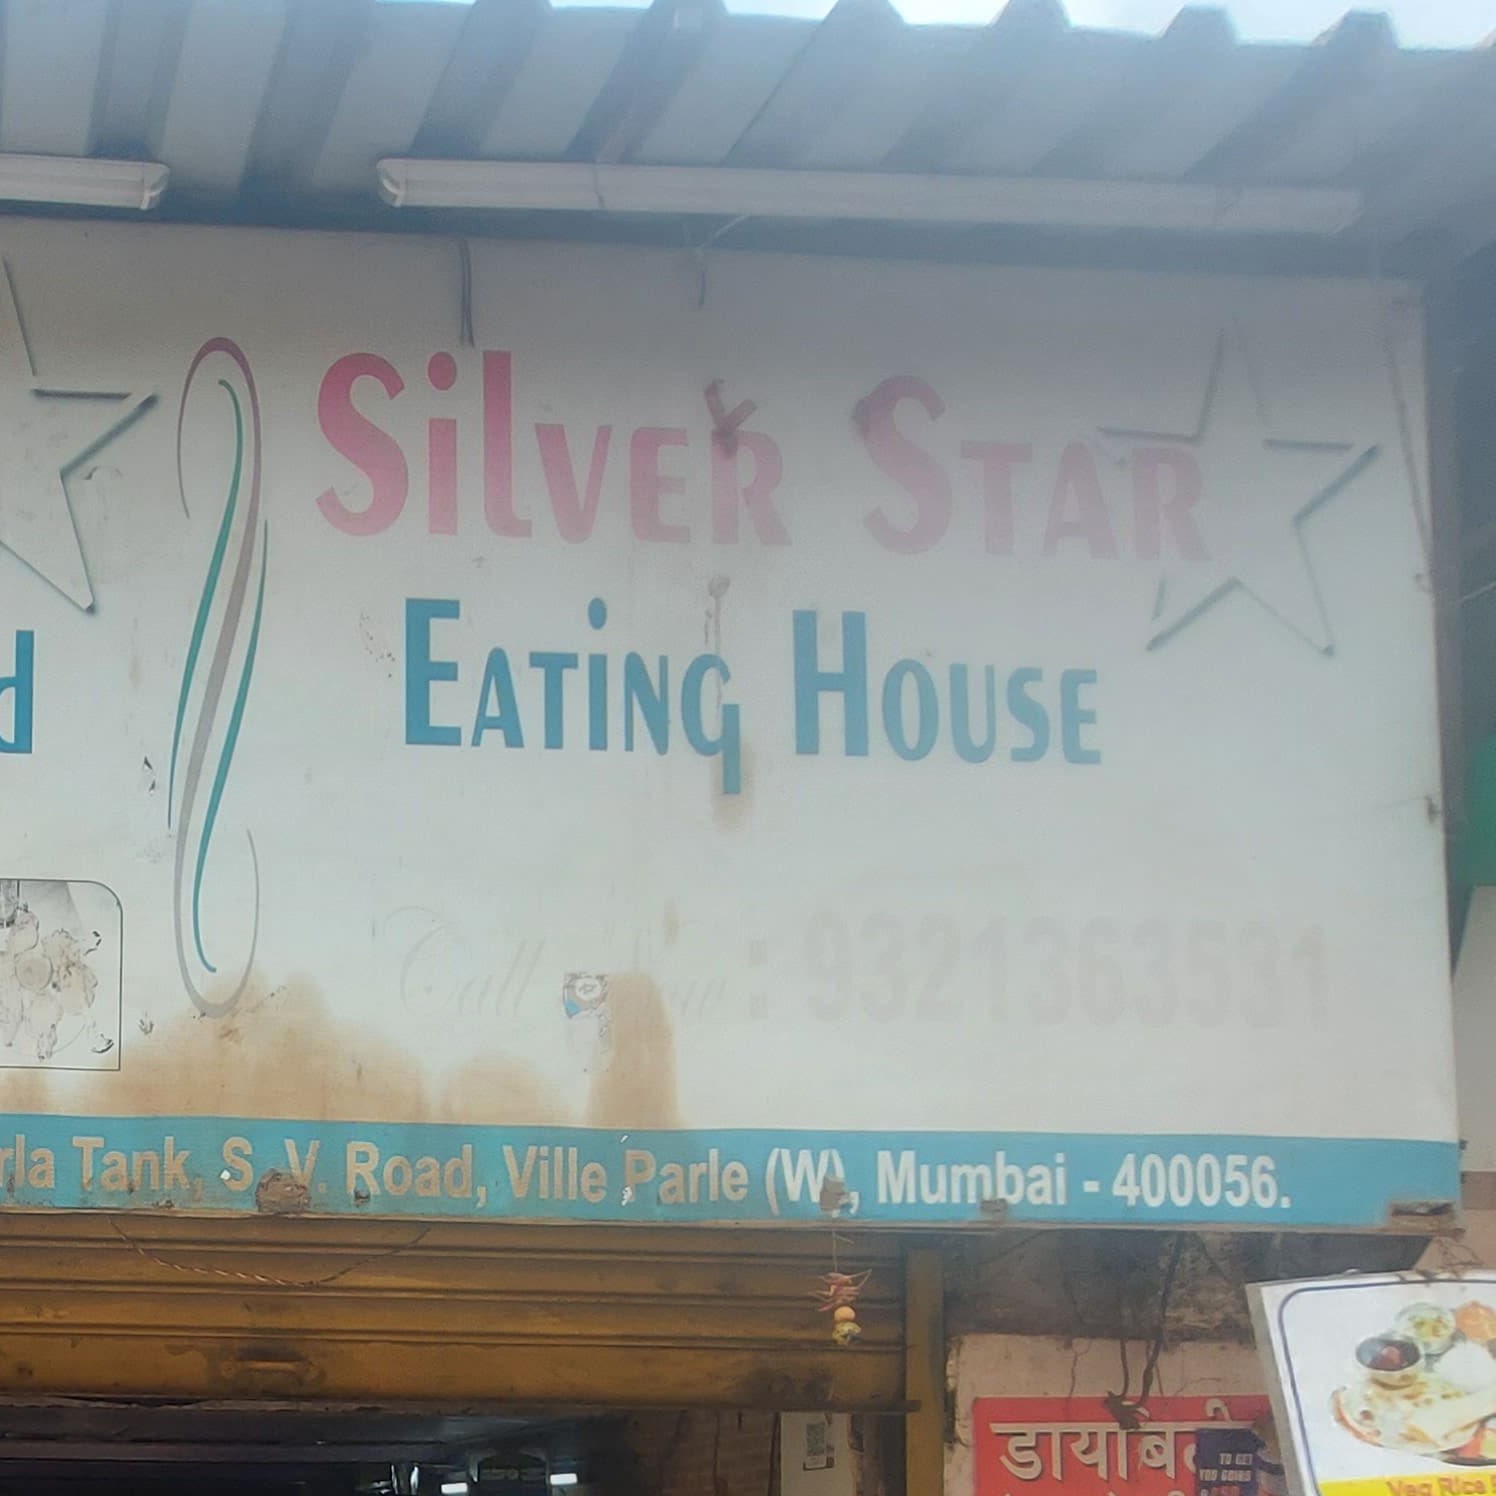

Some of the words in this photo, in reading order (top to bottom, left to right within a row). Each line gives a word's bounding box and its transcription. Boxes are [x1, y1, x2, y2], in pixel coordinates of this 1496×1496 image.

[346, 1142, 487, 1207] Road,
[502, 1145, 607, 1202] Ville
[626, 1149, 749, 1204] Parle
[877, 1150, 1069, 1205] Mumbai
[1112, 1153, 1291, 1209] 400056.
[1438, 1475, 1487, 1496] Rice
